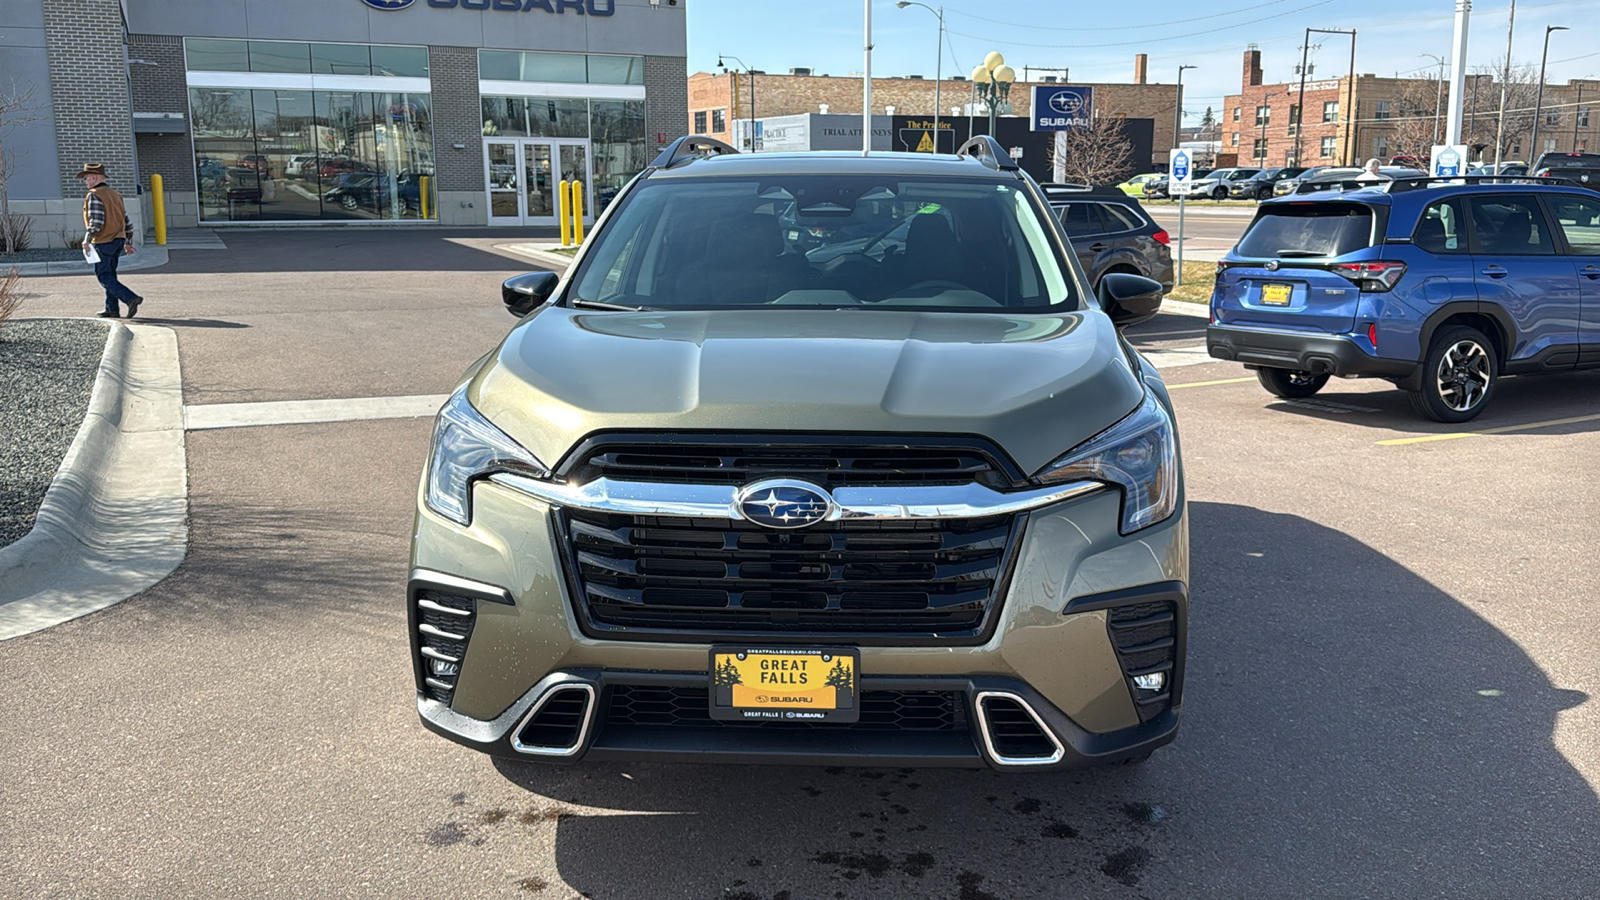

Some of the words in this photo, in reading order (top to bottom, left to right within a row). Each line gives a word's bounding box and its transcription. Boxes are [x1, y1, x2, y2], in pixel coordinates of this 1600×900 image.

[907, 120, 921, 129] The
[922, 120, 952, 129] Pratice
[1040, 118, 1088, 126] SUBARU
[822, 128, 847, 136] TRIAL
[848, 128, 893, 137] ATTNEYS
[760, 659, 808, 671] GREAT
[760, 672, 808, 684] FALLS
